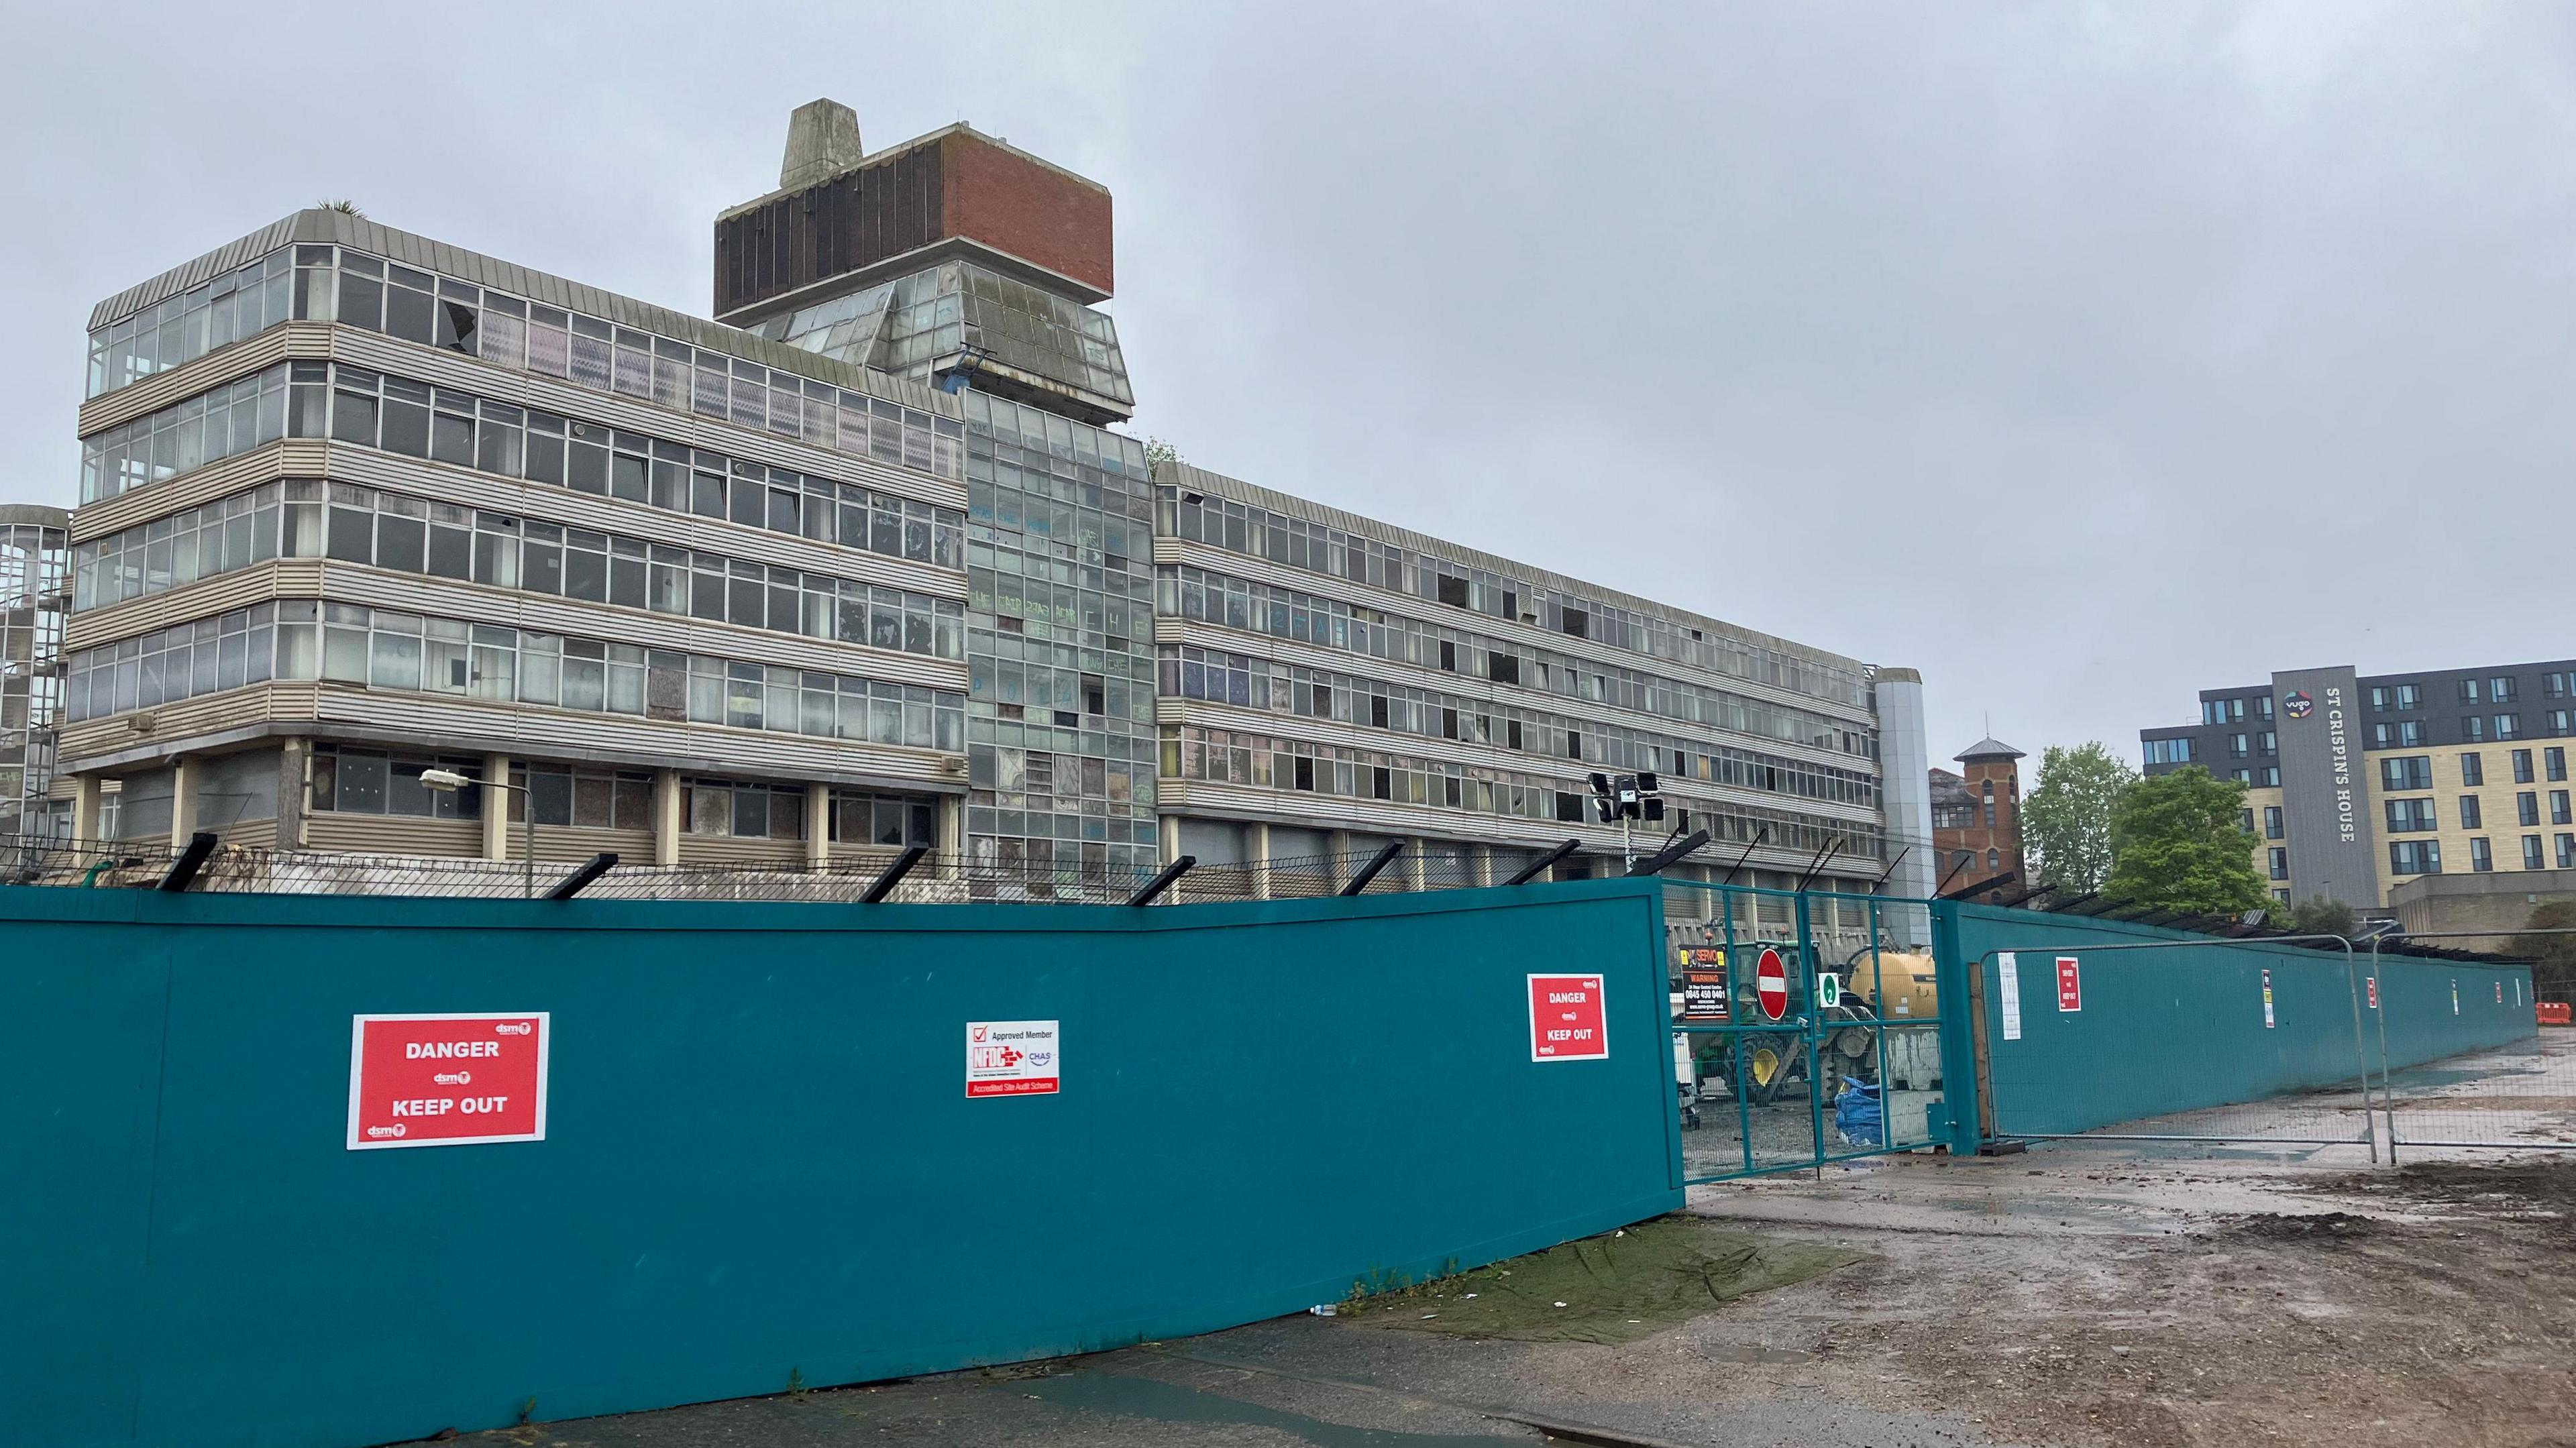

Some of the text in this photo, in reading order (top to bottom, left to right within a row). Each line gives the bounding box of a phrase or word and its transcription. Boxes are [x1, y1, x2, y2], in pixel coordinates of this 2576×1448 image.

[2327, 687, 2355, 843] ST CRISPIN'S HOUSE
[1697, 949, 1717, 962] SERVO
[1690, 974, 1719, 983] WARNING
[1549, 992, 1586, 1003] DANGER
[1701, 990, 1711, 999] 450
[1711, 990, 1725, 999] 0401
[1827, 989, 1833, 1003] 2
[993, 1031, 1053, 1041] Approved Member
[1547, 1028, 1592, 1041] KEEP OUT
[405, 1041, 499, 1059] DANGER
[973, 1046, 1006, 1068] NFDC
[973, 1082, 1053, 1093] Accredited Site Audit Scheme
[392, 1097, 508, 1117] KEEP OUT
